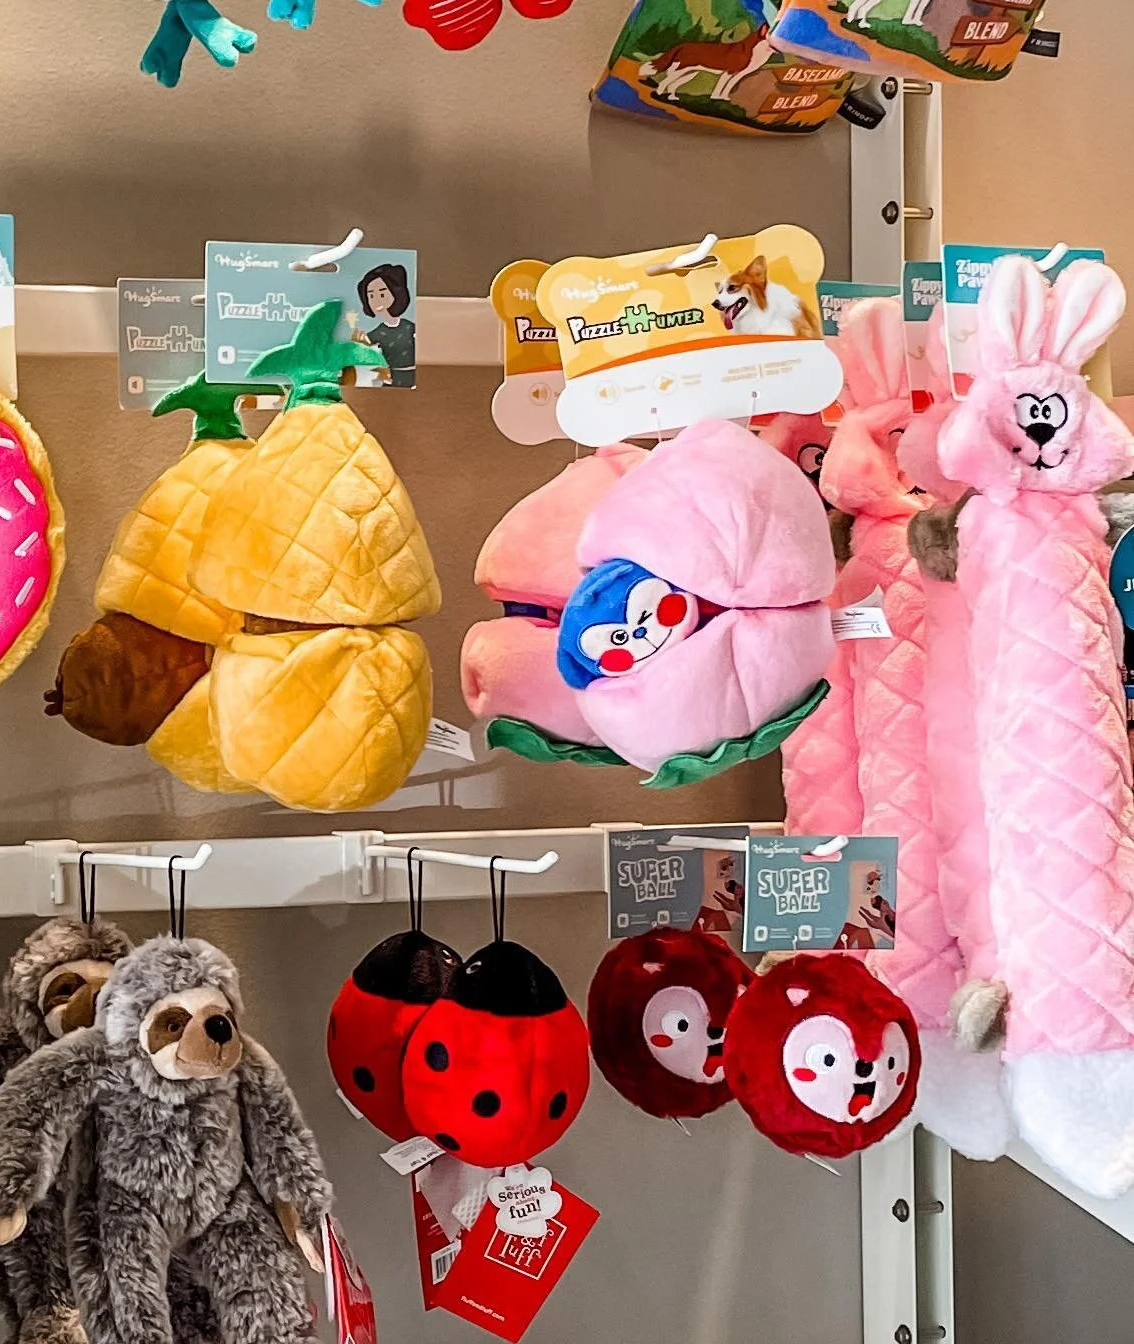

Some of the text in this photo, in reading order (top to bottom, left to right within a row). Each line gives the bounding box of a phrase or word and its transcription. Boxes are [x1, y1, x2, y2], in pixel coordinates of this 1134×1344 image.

[965, 19, 1011, 43] BLEND
[772, 93, 819, 110] BLEND
[214, 250, 280, 271] HugSmart
[566, 315, 624, 346] PUZZLE
[617, 855, 685, 888] SUPER
[757, 866, 830, 898] SUPER
[633, 879, 677, 902] BALL
[775, 894, 821, 916] BALL
[497, 1185, 546, 1203] Serious
[508, 1198, 542, 1221] fun!
